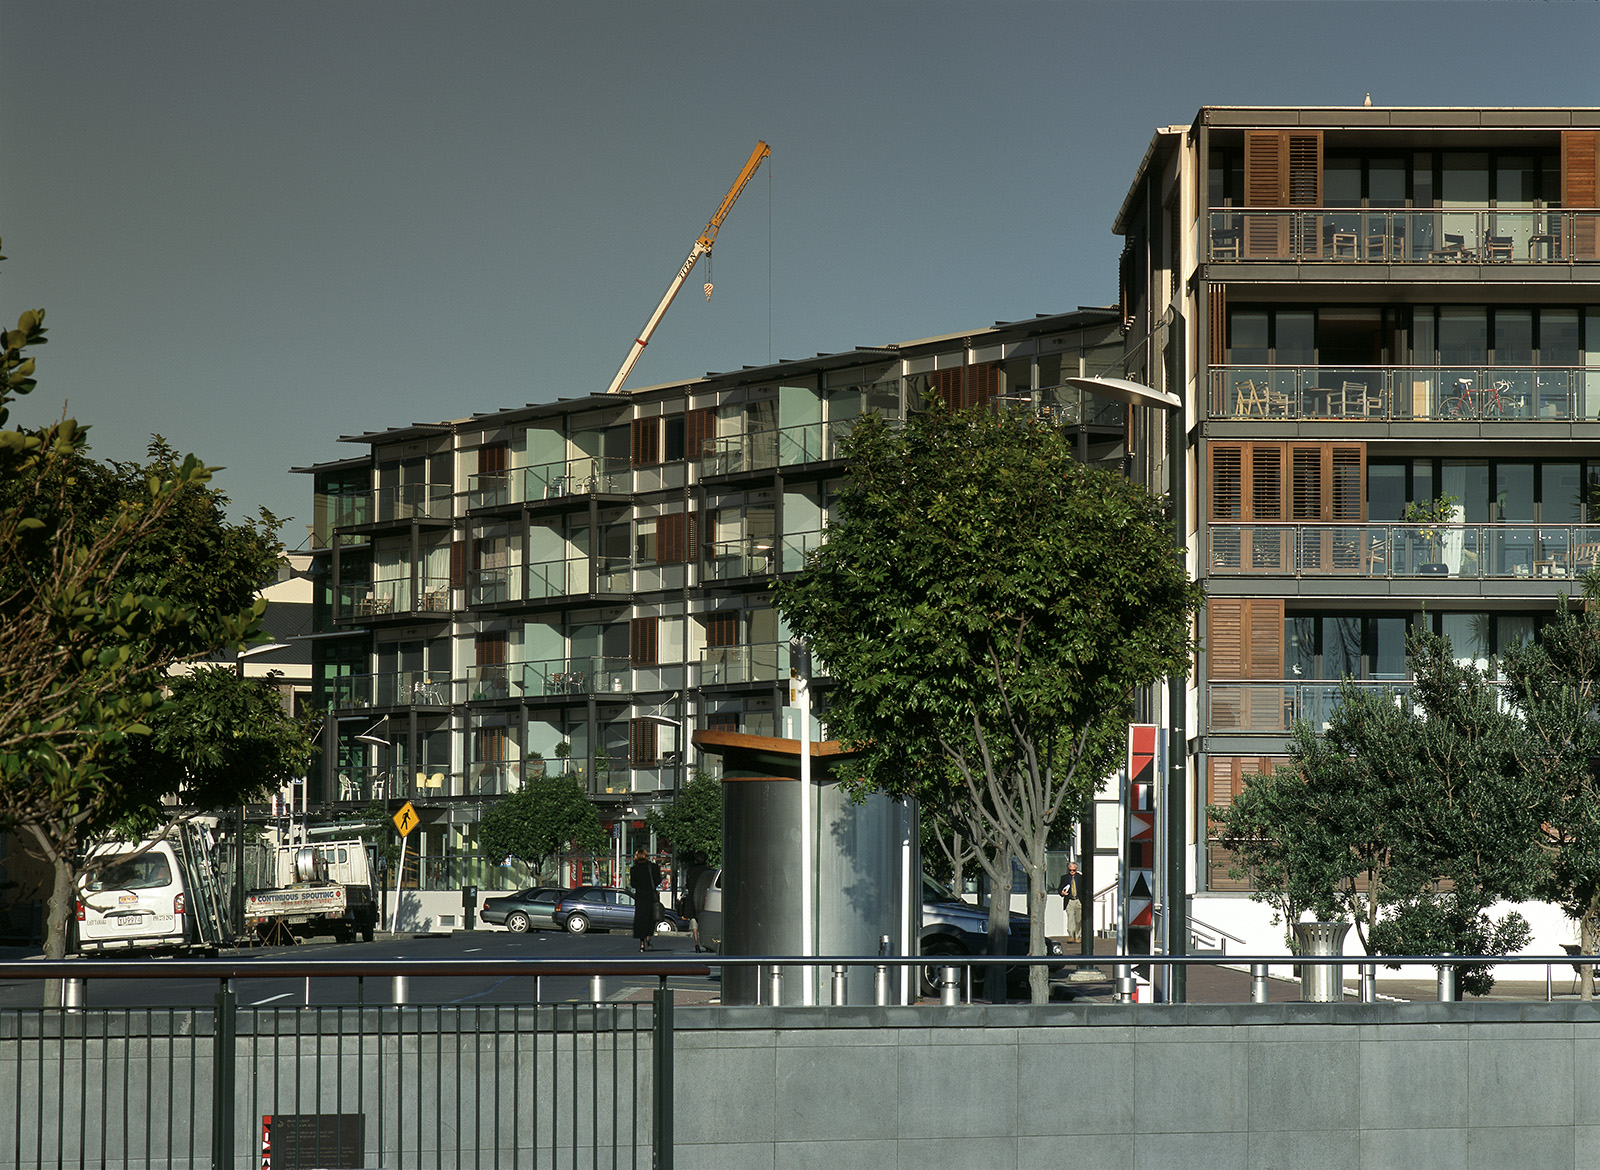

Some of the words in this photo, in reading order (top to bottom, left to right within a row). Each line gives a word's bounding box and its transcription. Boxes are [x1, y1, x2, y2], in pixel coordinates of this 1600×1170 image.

[678, 252, 696, 279] TITAN
[258, 893, 299, 902] CONTINUOUS
[302, 891, 334, 900] SPOUTING
